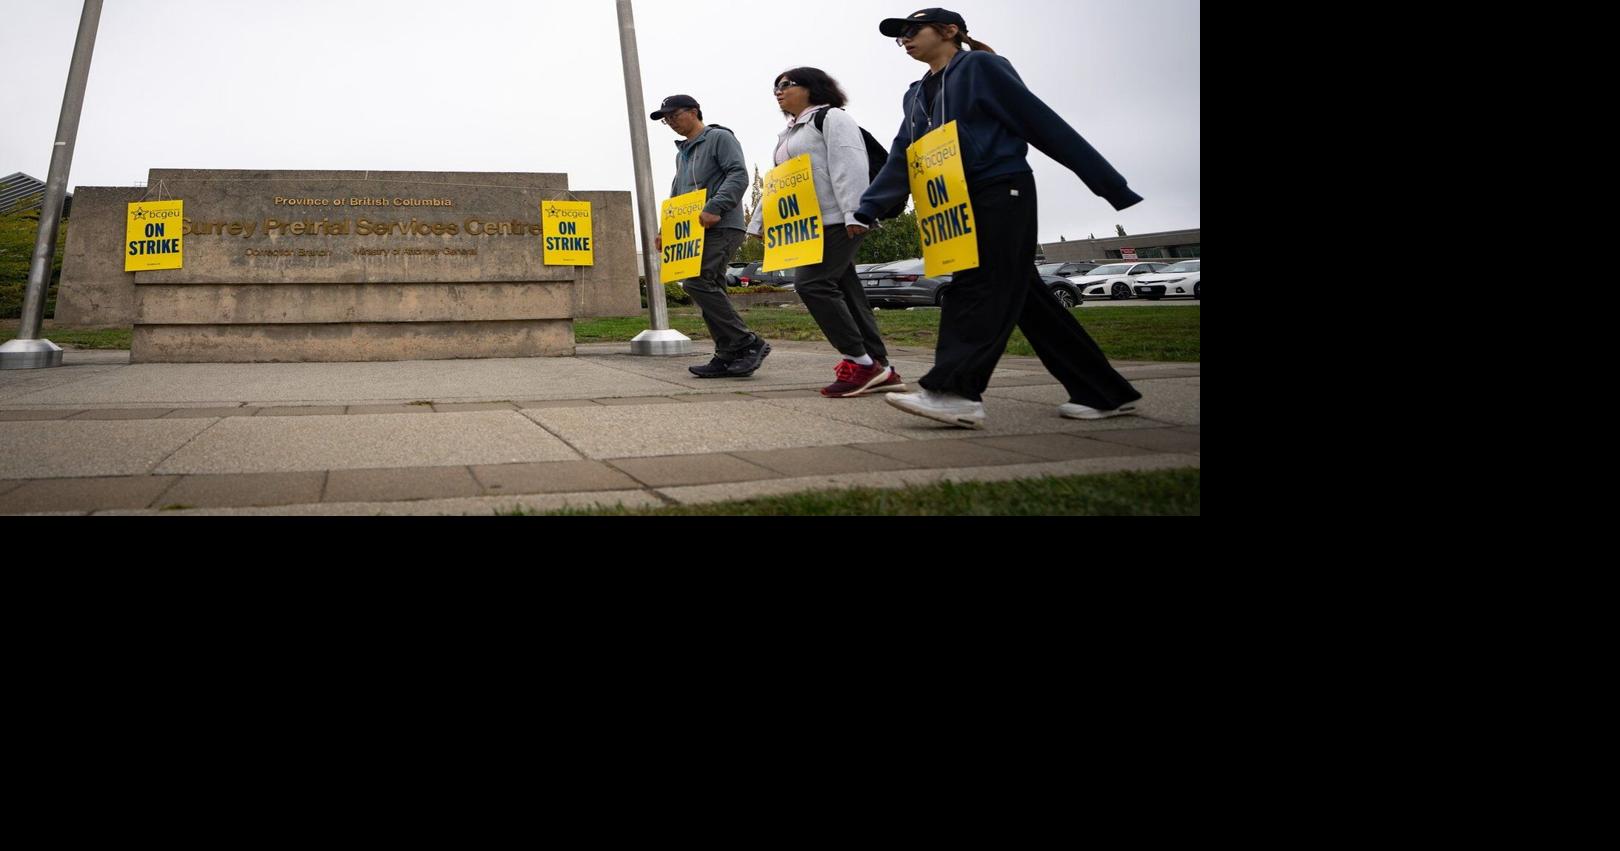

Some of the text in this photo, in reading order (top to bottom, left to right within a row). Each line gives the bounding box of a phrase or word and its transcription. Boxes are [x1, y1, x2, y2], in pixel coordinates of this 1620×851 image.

[925, 144, 956, 169] bcgeu
[778, 170, 810, 190] bcgeu
[926, 174, 949, 209] ON
[274, 196, 452, 207] Province of British Columbia
[677, 203, 703, 216] bcgeu
[778, 193, 800, 219] ON
[149, 209, 180, 220] bcgeu
[561, 208, 589, 219] bcgeu
[145, 223, 165, 238] ON
[182, 217, 543, 238] Surrey Pretrial Services Centre
[559, 221, 576, 235] ON
[675, 220, 690, 240] ON
[767, 215, 820, 249] STRIKE
[921, 202, 972, 247] STRIKE
[129, 239, 180, 256] STRIKE
[298, 248, 332, 257] Branch
[354, 247, 389, 257] Ministry
[443, 247, 478, 257] General
[546, 237, 590, 251] STRIKE
[663, 238, 702, 264] STRIKE
